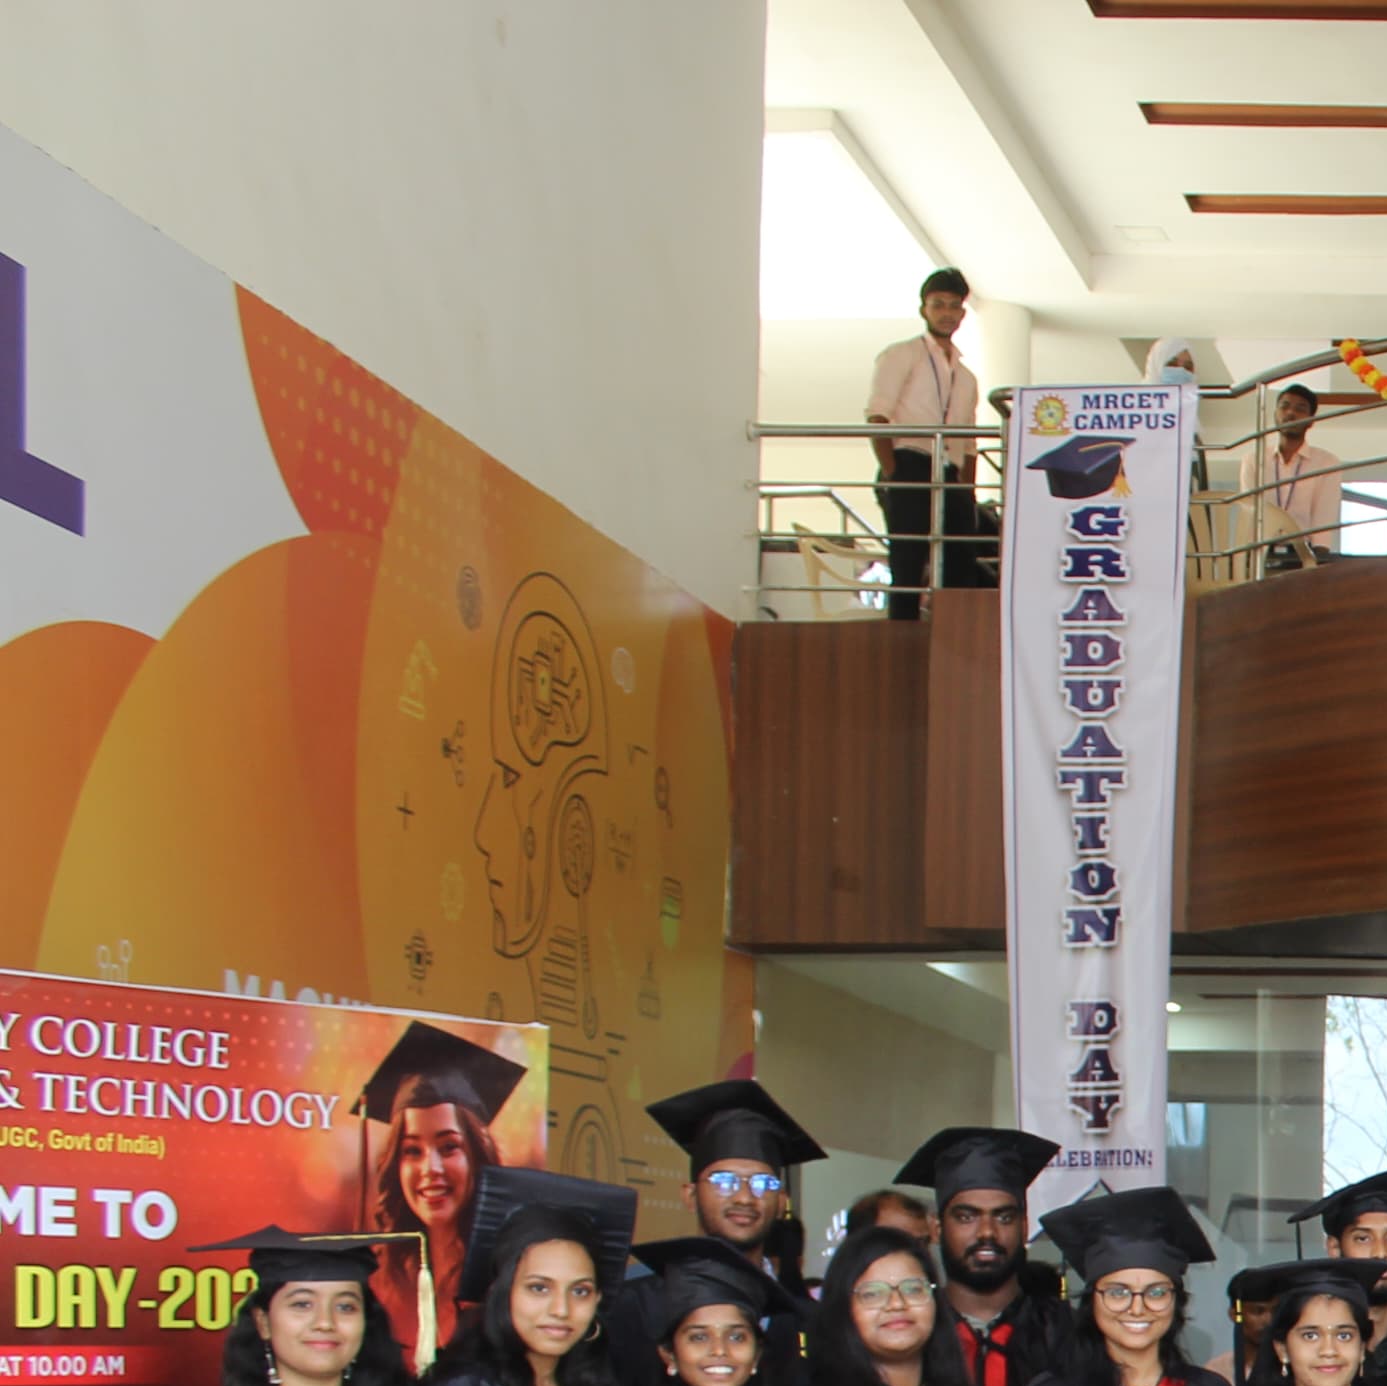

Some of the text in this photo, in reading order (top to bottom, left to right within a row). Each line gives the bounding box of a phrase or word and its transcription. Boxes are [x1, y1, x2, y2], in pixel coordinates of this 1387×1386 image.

[1073, 413, 1177, 430] CAMPUS
[1082, 393, 1170, 410] MRCET
[1057, 503, 1130, 1133] GRADUATION DAY
[29, 1016, 230, 1069] COLLEGE
[32, 1072, 340, 1130] TECHNOLOGY
[49, 1129, 92, 1152] Govt
[95, 1132, 115, 1153] of
[117, 1133, 165, 1160] India)
[93, 1188, 178, 1240] TO
[15, 1264, 259, 1331] DAY-202
[28, 1355, 87, 1376] 10.00
[91, 1355, 125, 1376] AM
